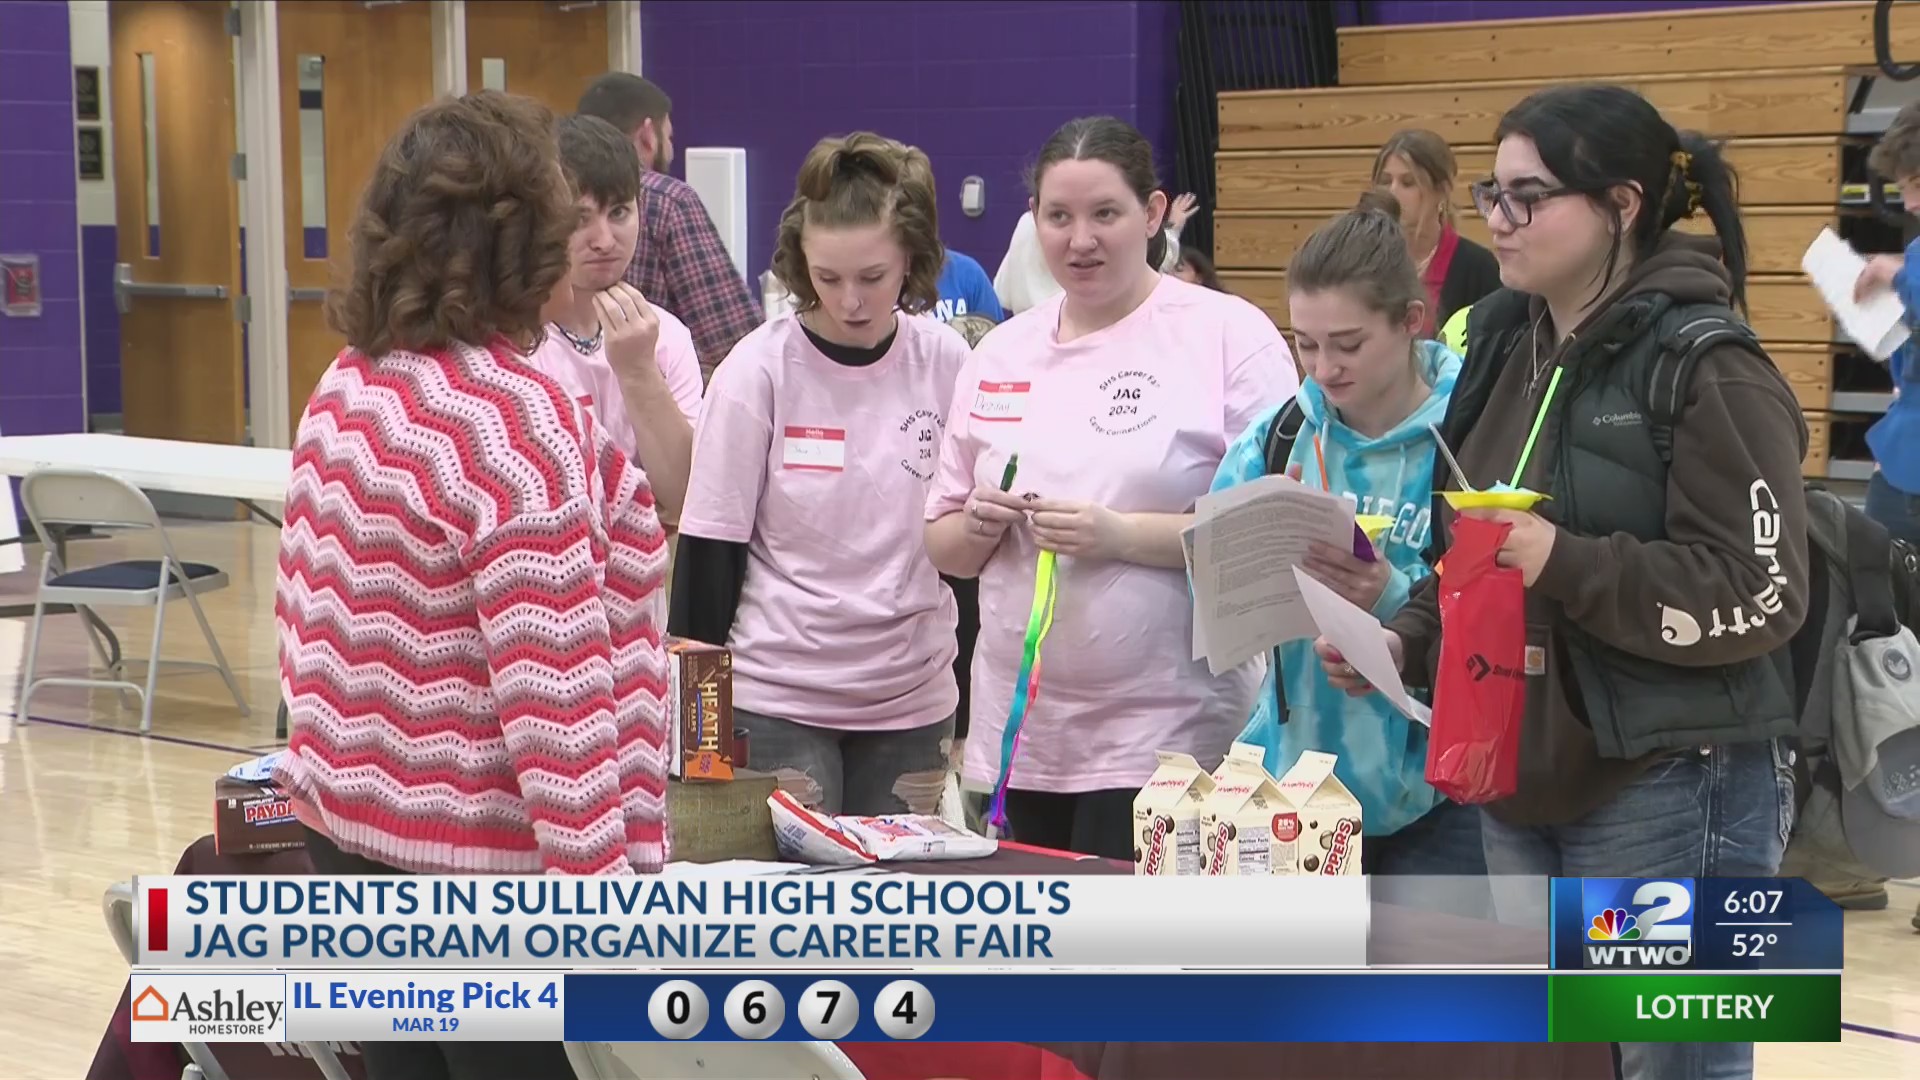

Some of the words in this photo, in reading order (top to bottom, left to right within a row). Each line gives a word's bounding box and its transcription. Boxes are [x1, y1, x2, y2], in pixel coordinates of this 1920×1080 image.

[1112, 388, 1141, 400] JAG
[1108, 405, 1138, 416] 2024
[918, 428, 931, 441] JG
[698, 682, 718, 750] HEATH
